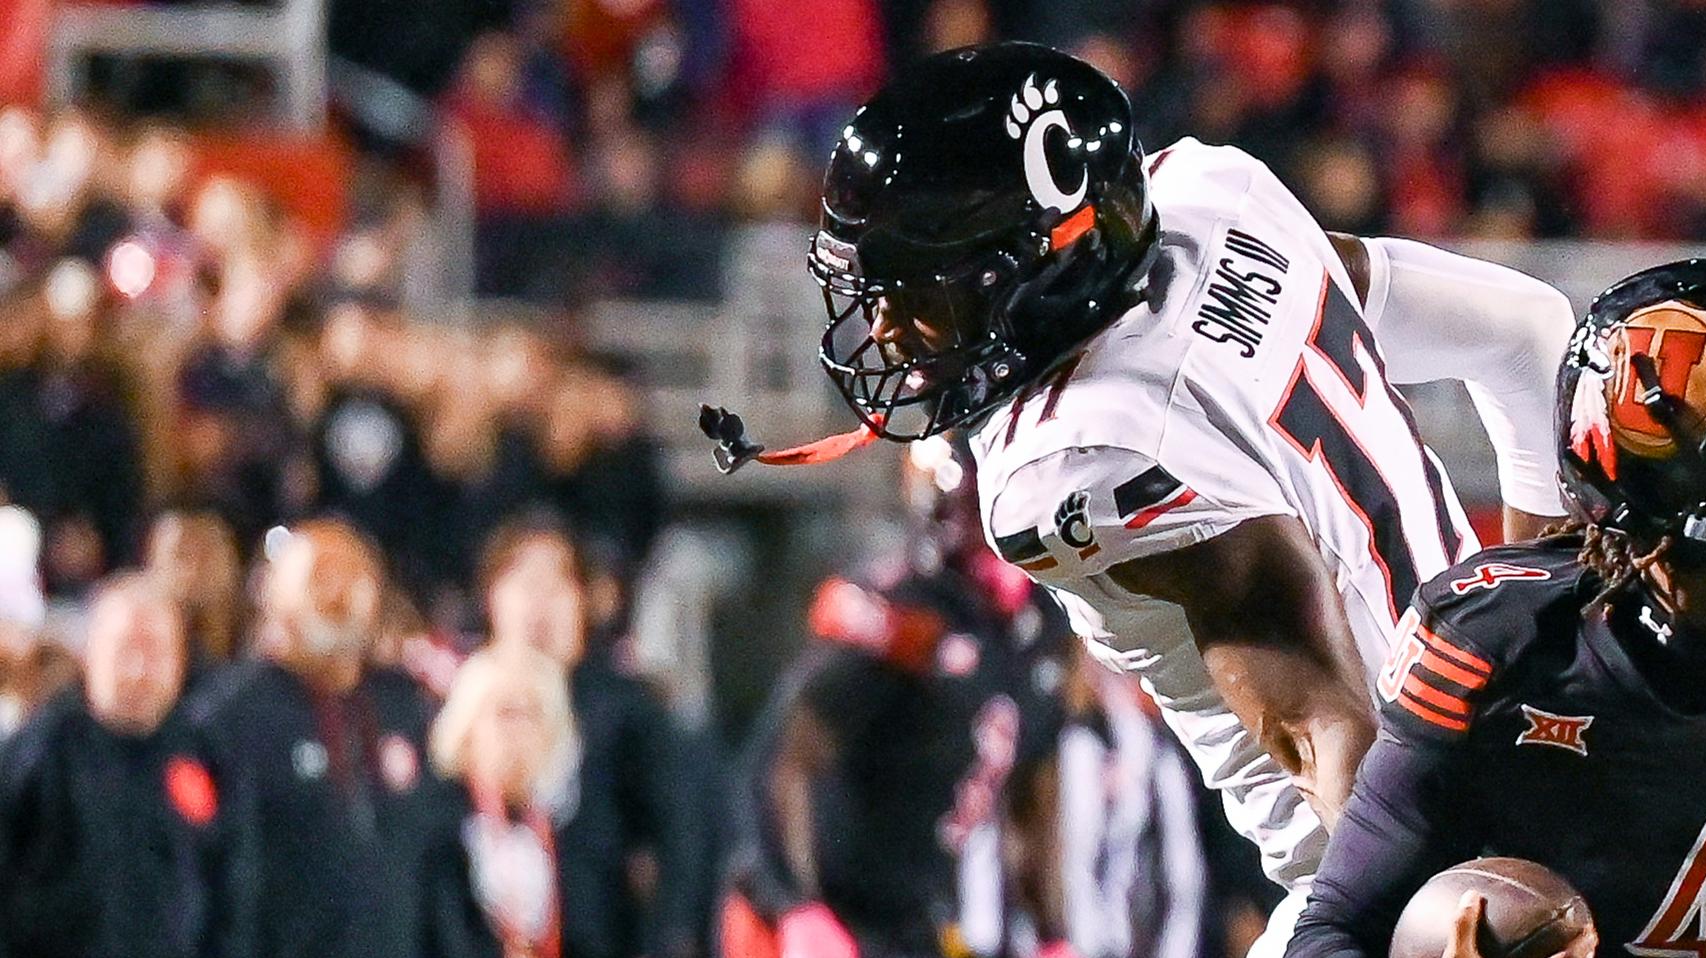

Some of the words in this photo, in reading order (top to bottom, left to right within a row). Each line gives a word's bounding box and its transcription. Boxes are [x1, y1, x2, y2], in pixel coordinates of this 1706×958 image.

[1017, 92, 1088, 214] C
[1225, 229, 1289, 274] III
[1192, 258, 1281, 358] SIMMS
[1267, 265, 1463, 627] 17
[1450, 563, 1551, 595] 4
[1516, 704, 1594, 757] XII
